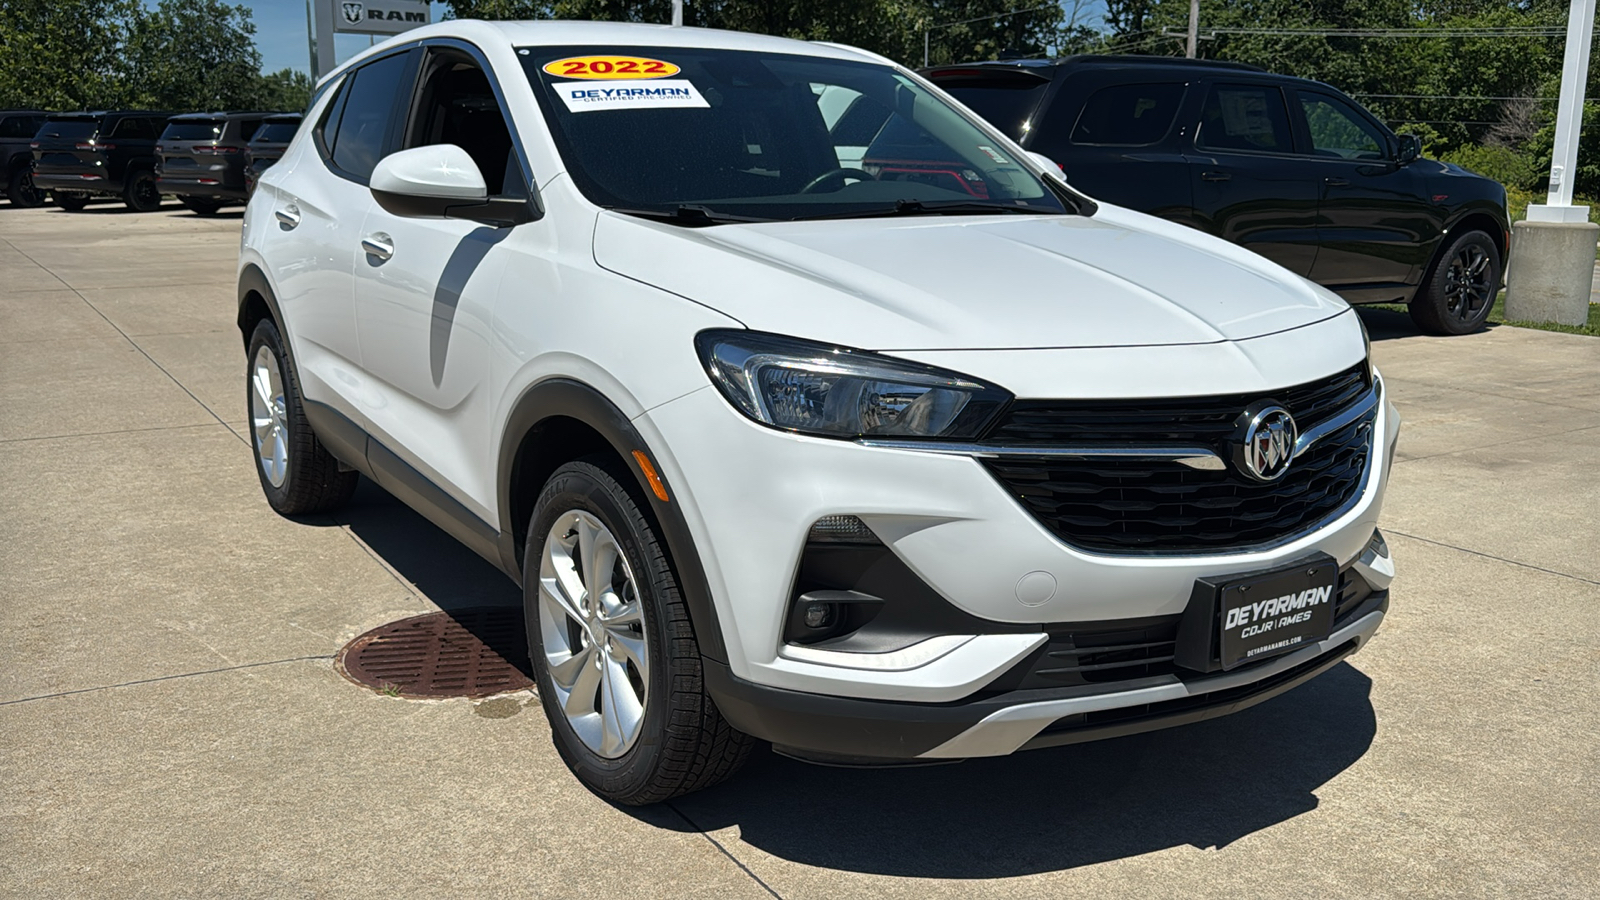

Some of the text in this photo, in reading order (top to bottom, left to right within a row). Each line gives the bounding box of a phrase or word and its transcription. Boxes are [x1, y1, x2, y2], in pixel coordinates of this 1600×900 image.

[367, 9, 425, 22] RAM
[562, 61, 668, 75] 2022
[571, 88, 690, 99] DEYARMAN
[538, 478, 569, 514] KELLY
[1225, 585, 1332, 630] DEYARMAN
[1241, 611, 1312, 639] CDJR AMES
[1247, 636, 1302, 657] DEYARMANAMES.COM
